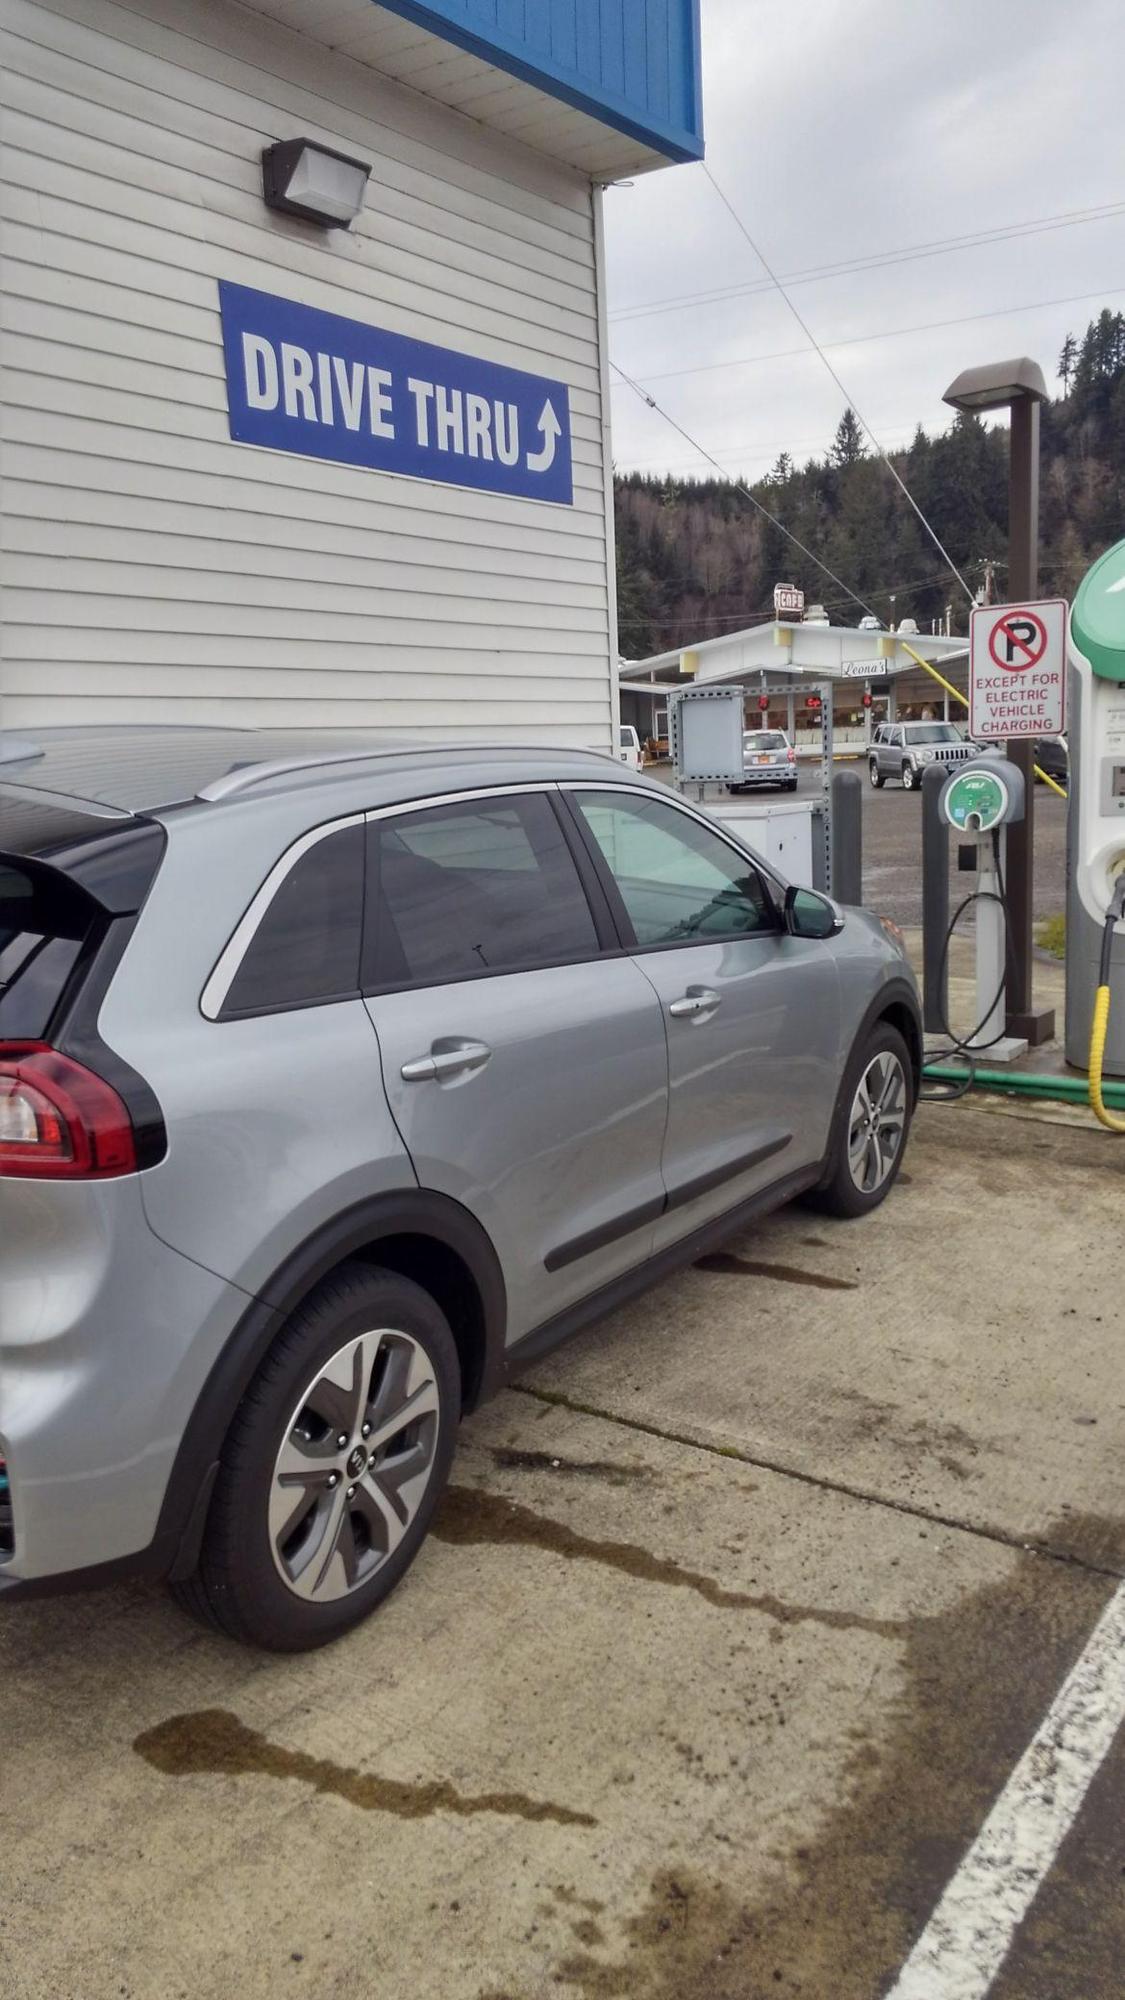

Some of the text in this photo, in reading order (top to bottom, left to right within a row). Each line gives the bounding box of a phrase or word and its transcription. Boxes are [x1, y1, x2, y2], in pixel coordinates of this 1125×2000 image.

[242, 331, 520, 466] DRIVE THRU
[845, 661, 885, 675] Leona's
[976, 673, 1060, 689] EXCEPT FOR
[985, 688, 1049, 703] ELECTRIC
[989, 704, 1045, 717] VEHICLE
[981, 718, 1053, 733] CHARGING
